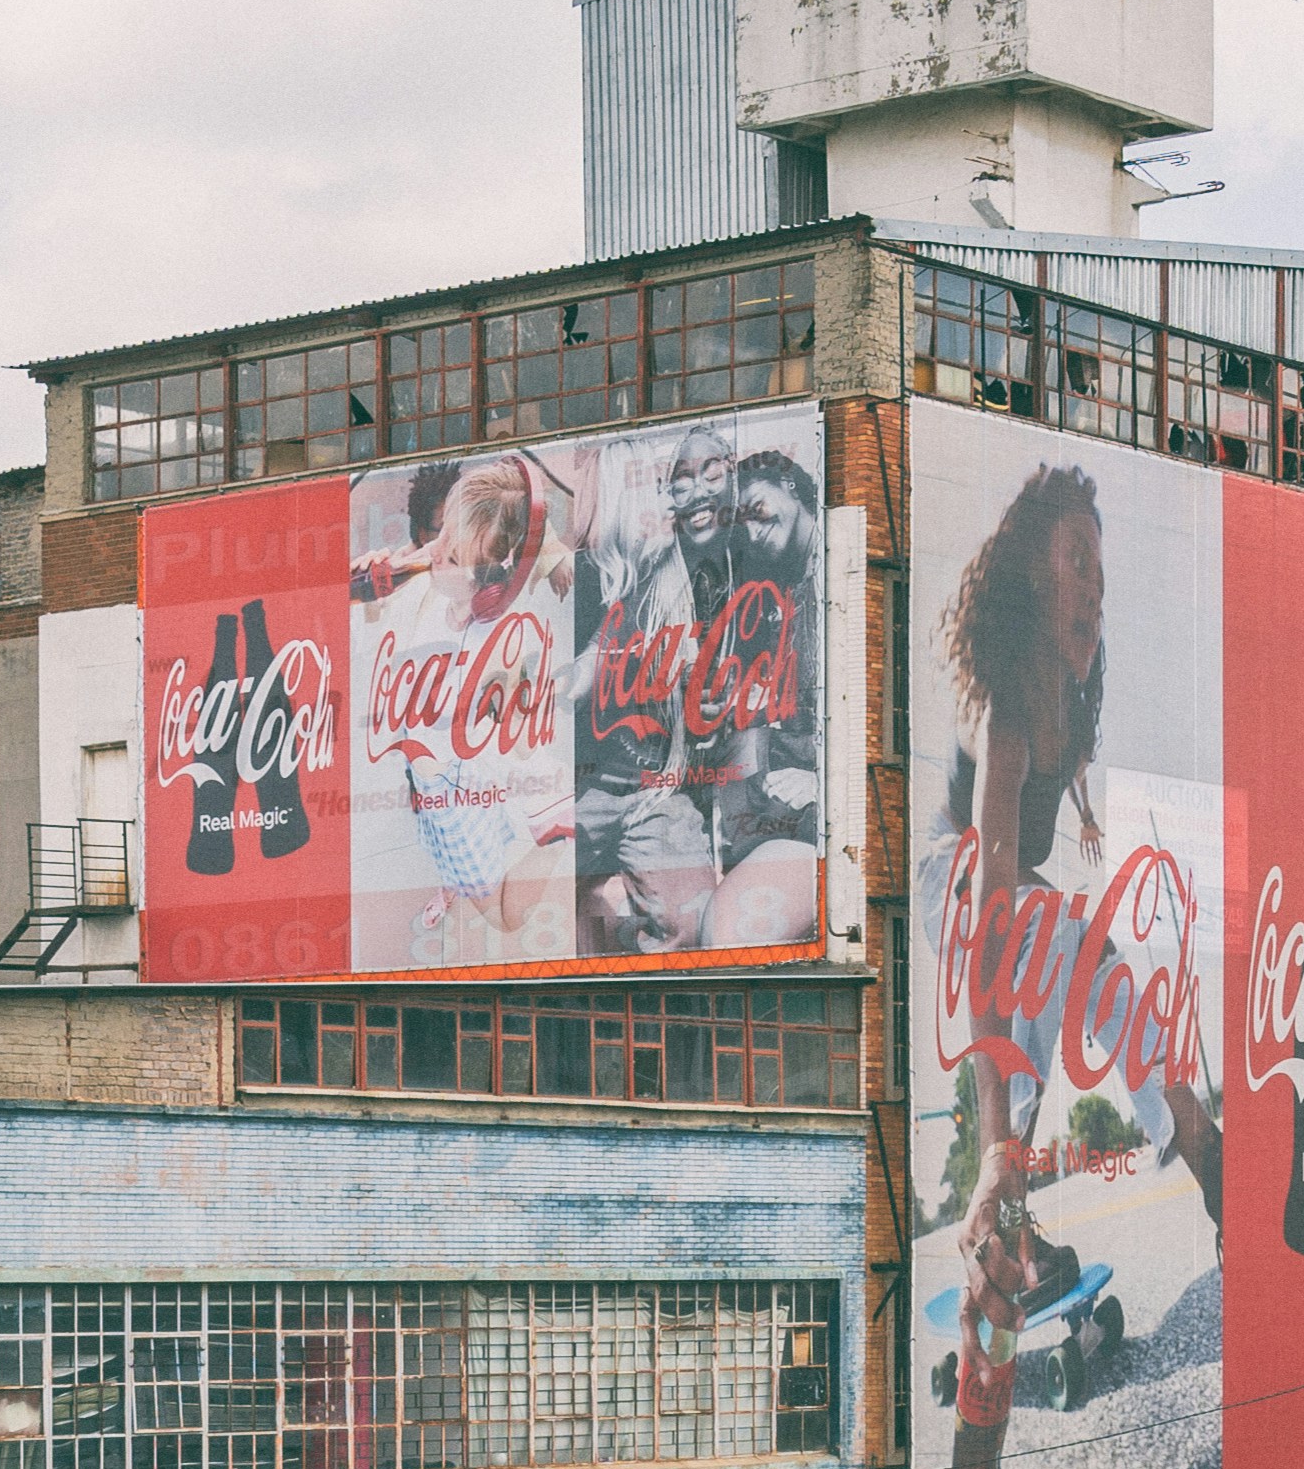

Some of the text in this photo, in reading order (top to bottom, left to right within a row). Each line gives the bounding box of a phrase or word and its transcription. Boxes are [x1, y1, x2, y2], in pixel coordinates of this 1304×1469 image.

[367, 611, 557, 763] Coca-Cola
[591, 580, 799, 742] Coca-Cola
[158, 638, 335, 789] Coca-Cola
[199, 807, 289, 833] Real Magic
[412, 783, 506, 812] Real Magic
[640, 761, 744, 789] Real Magic
[937, 825, 1200, 1091] Coca-Cola
[1005, 1139, 1137, 1183] Real Magic
